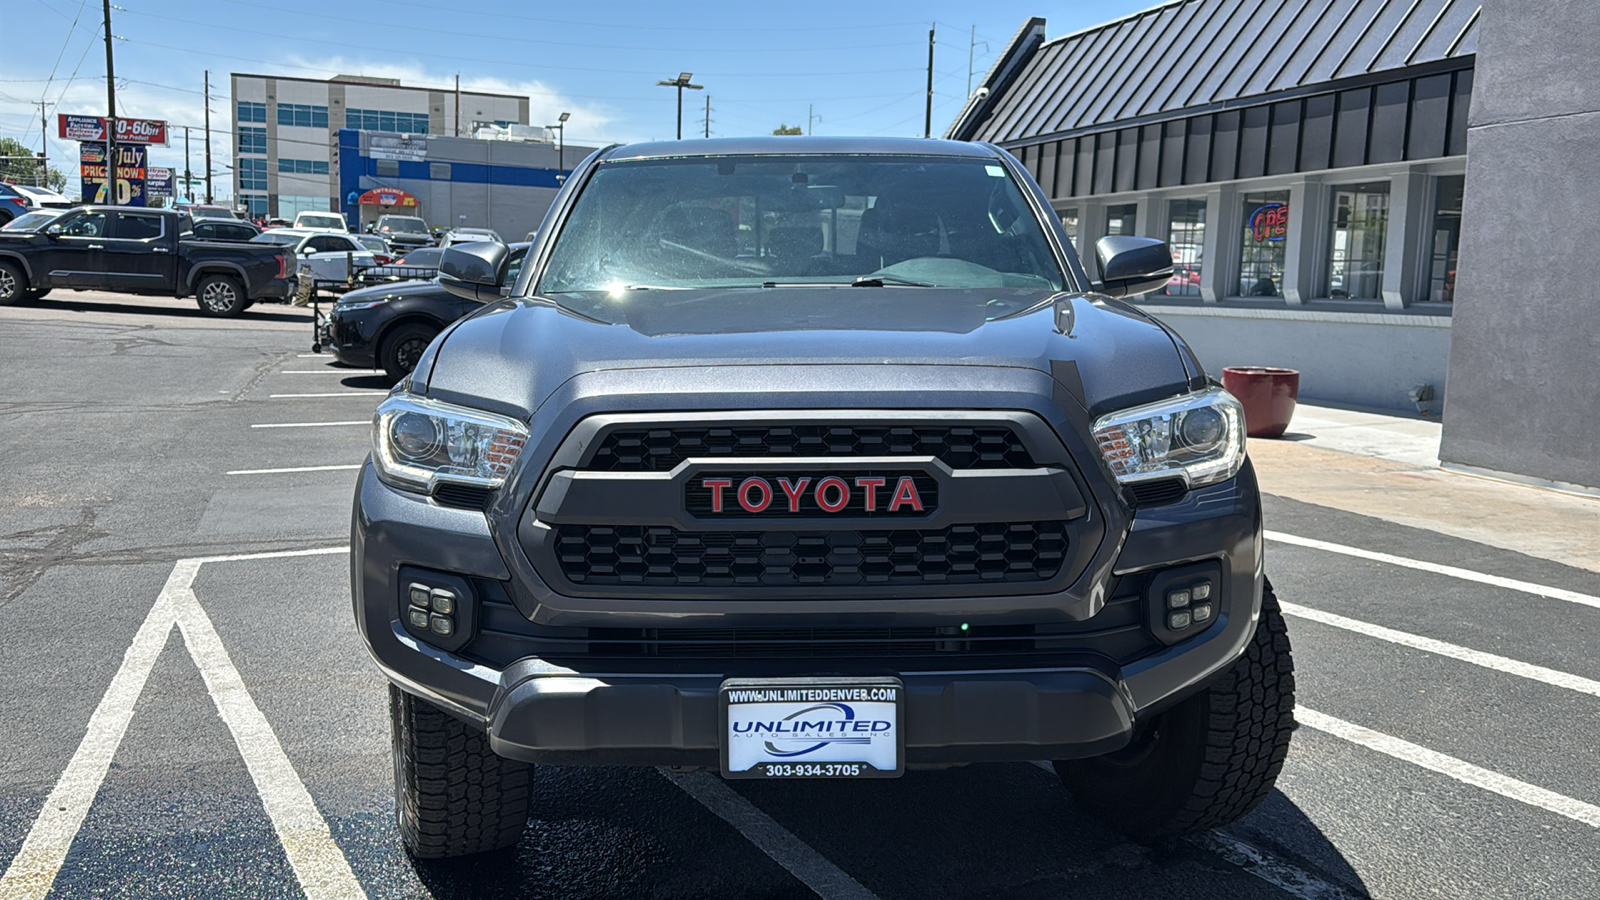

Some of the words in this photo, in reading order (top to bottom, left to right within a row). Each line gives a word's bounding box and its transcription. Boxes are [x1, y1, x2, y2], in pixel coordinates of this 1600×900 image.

[115, 120, 148, 135] 0-60
[117, 147, 143, 167] July
[84, 165, 108, 177] PRIC
[116, 167, 139, 179] NOW
[373, 187, 405, 196] ENTRANCE
[1255, 206, 1288, 241] OPE
[702, 475, 924, 513] TOYOTA
[732, 720, 892, 733] UNLIMITED
[766, 764, 860, 777] 303-934-3705
